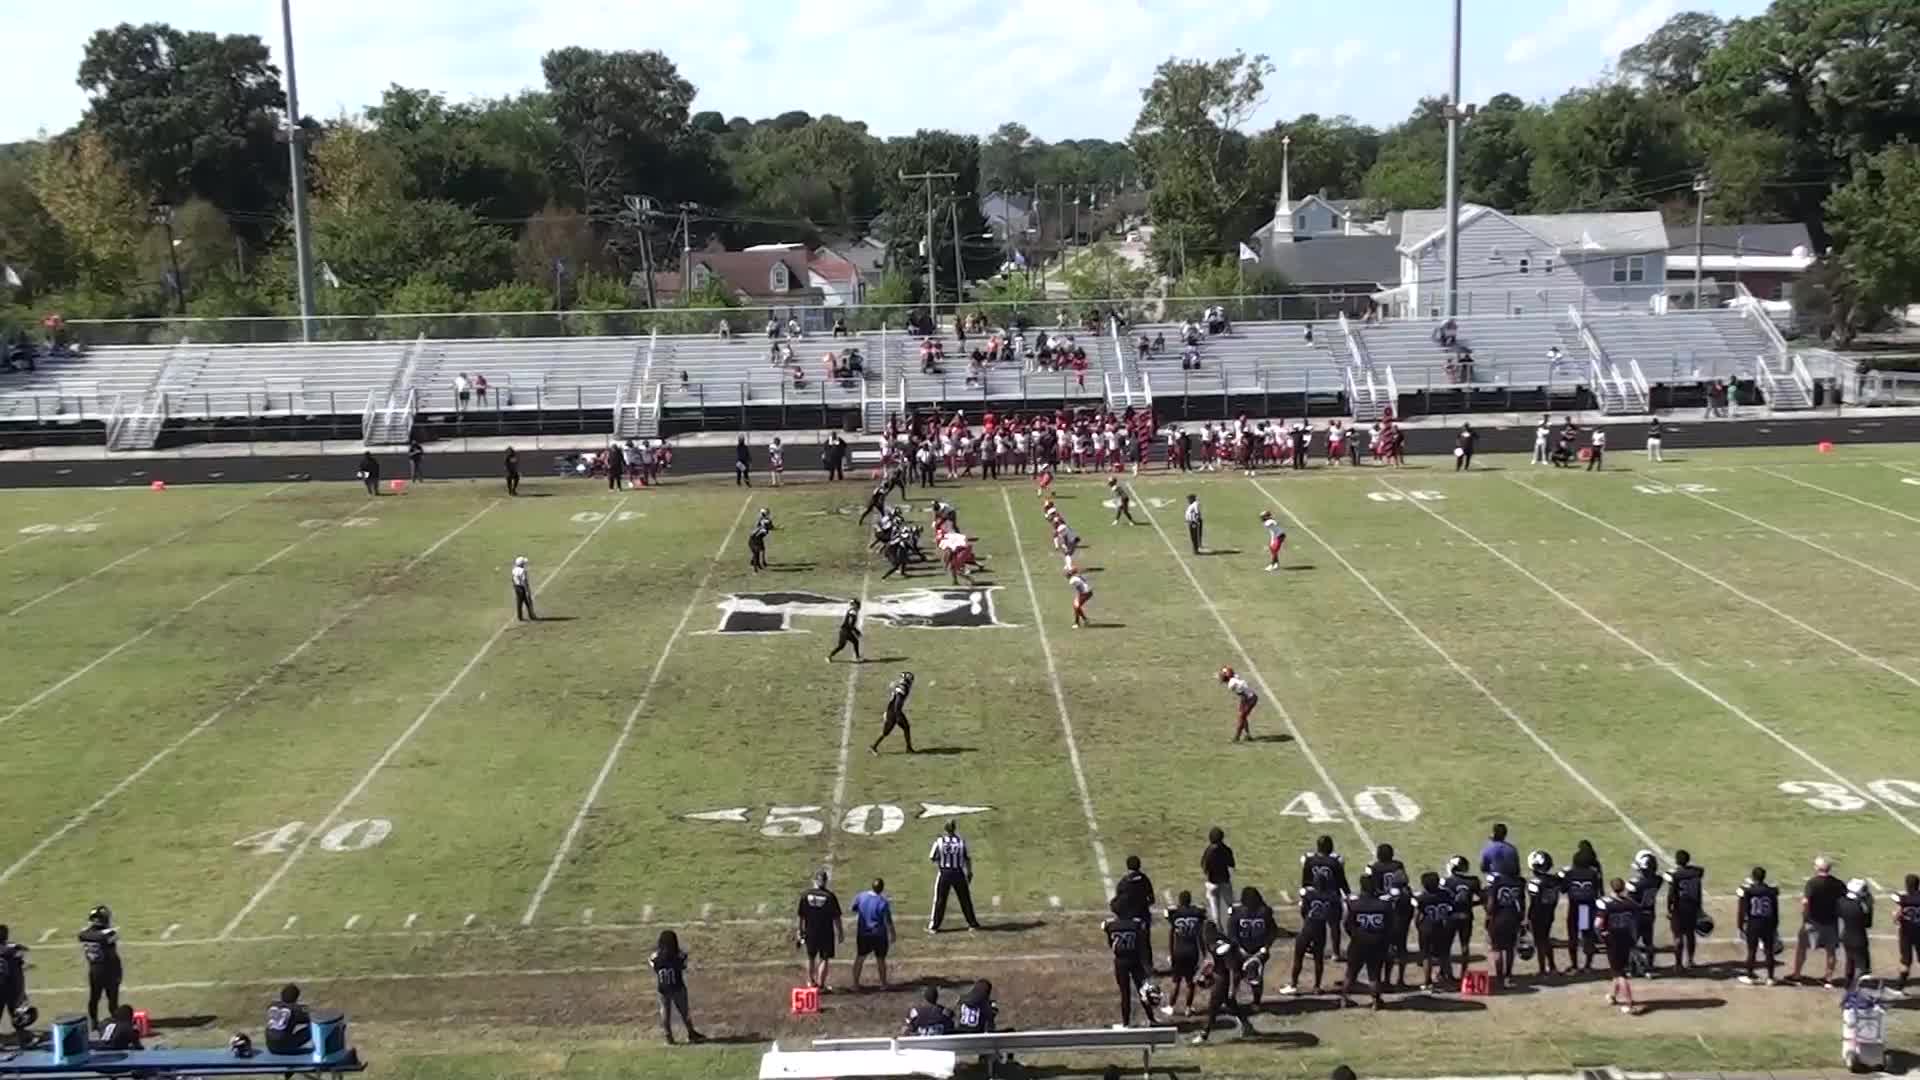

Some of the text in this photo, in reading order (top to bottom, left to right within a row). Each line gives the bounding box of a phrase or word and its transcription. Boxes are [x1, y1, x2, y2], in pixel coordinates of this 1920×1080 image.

[760, 804, 905, 837] 50
[1280, 786, 1421, 822] 40
[232, 818, 393, 854] 40
[795, 991, 815, 1010] 50
